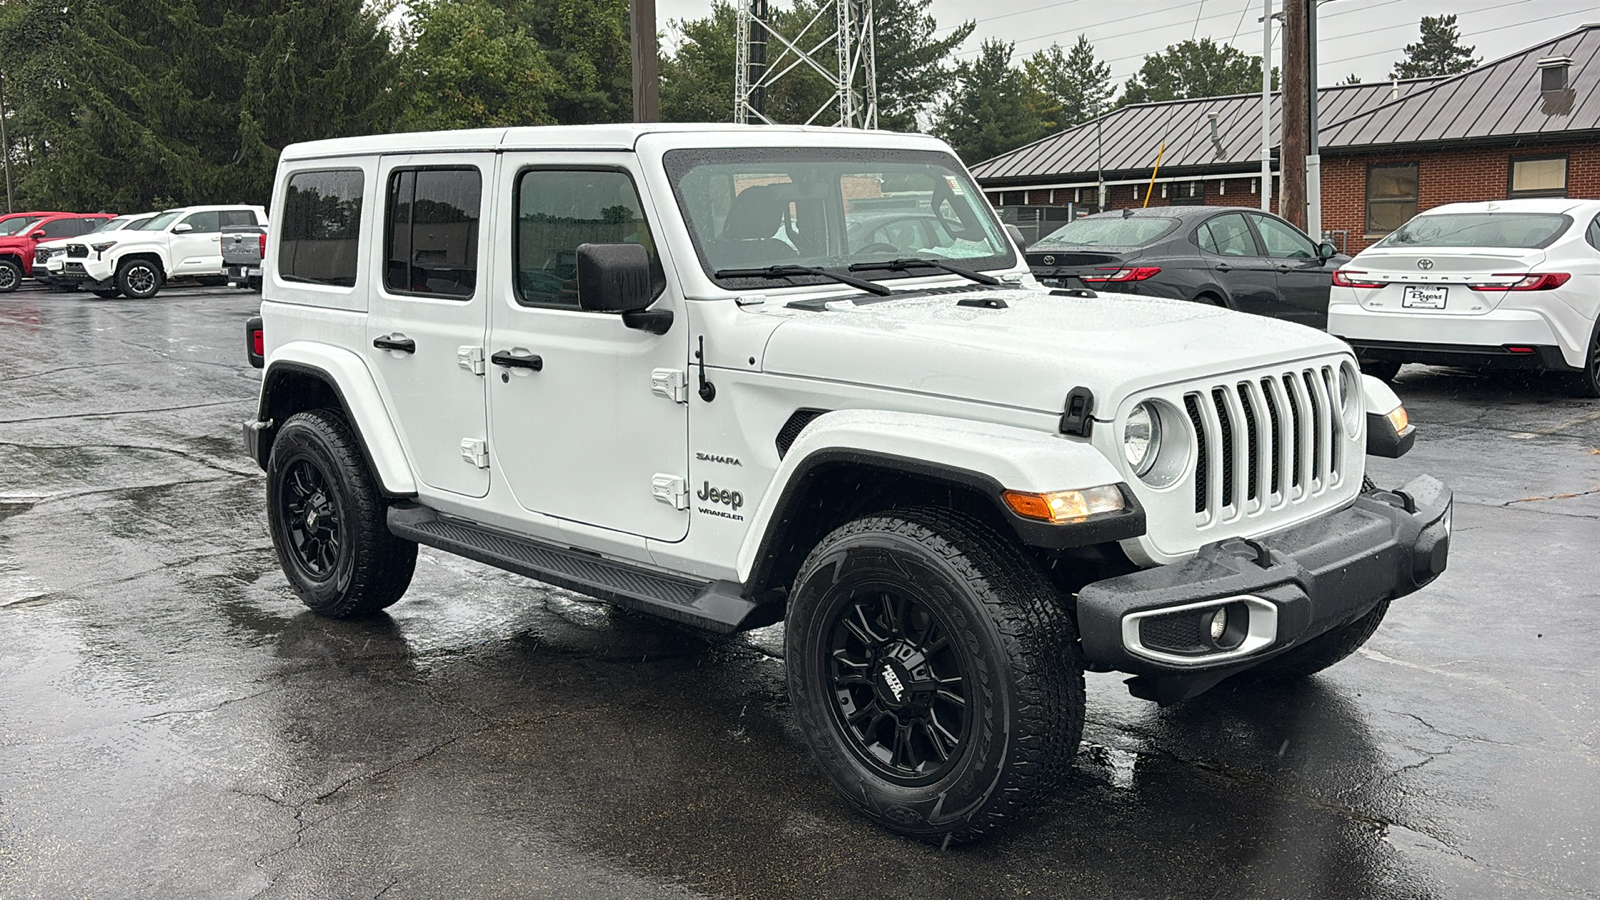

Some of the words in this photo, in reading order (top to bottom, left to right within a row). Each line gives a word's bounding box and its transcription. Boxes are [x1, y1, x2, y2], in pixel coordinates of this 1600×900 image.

[1409, 290, 1442, 303] Byers
[696, 452, 743, 467] SAHARA
[697, 480, 743, 510] Jeep
[698, 506, 744, 521] WRANGLER
[882, 671, 902, 702] METAL
[883, 664, 904, 690] MOTO
